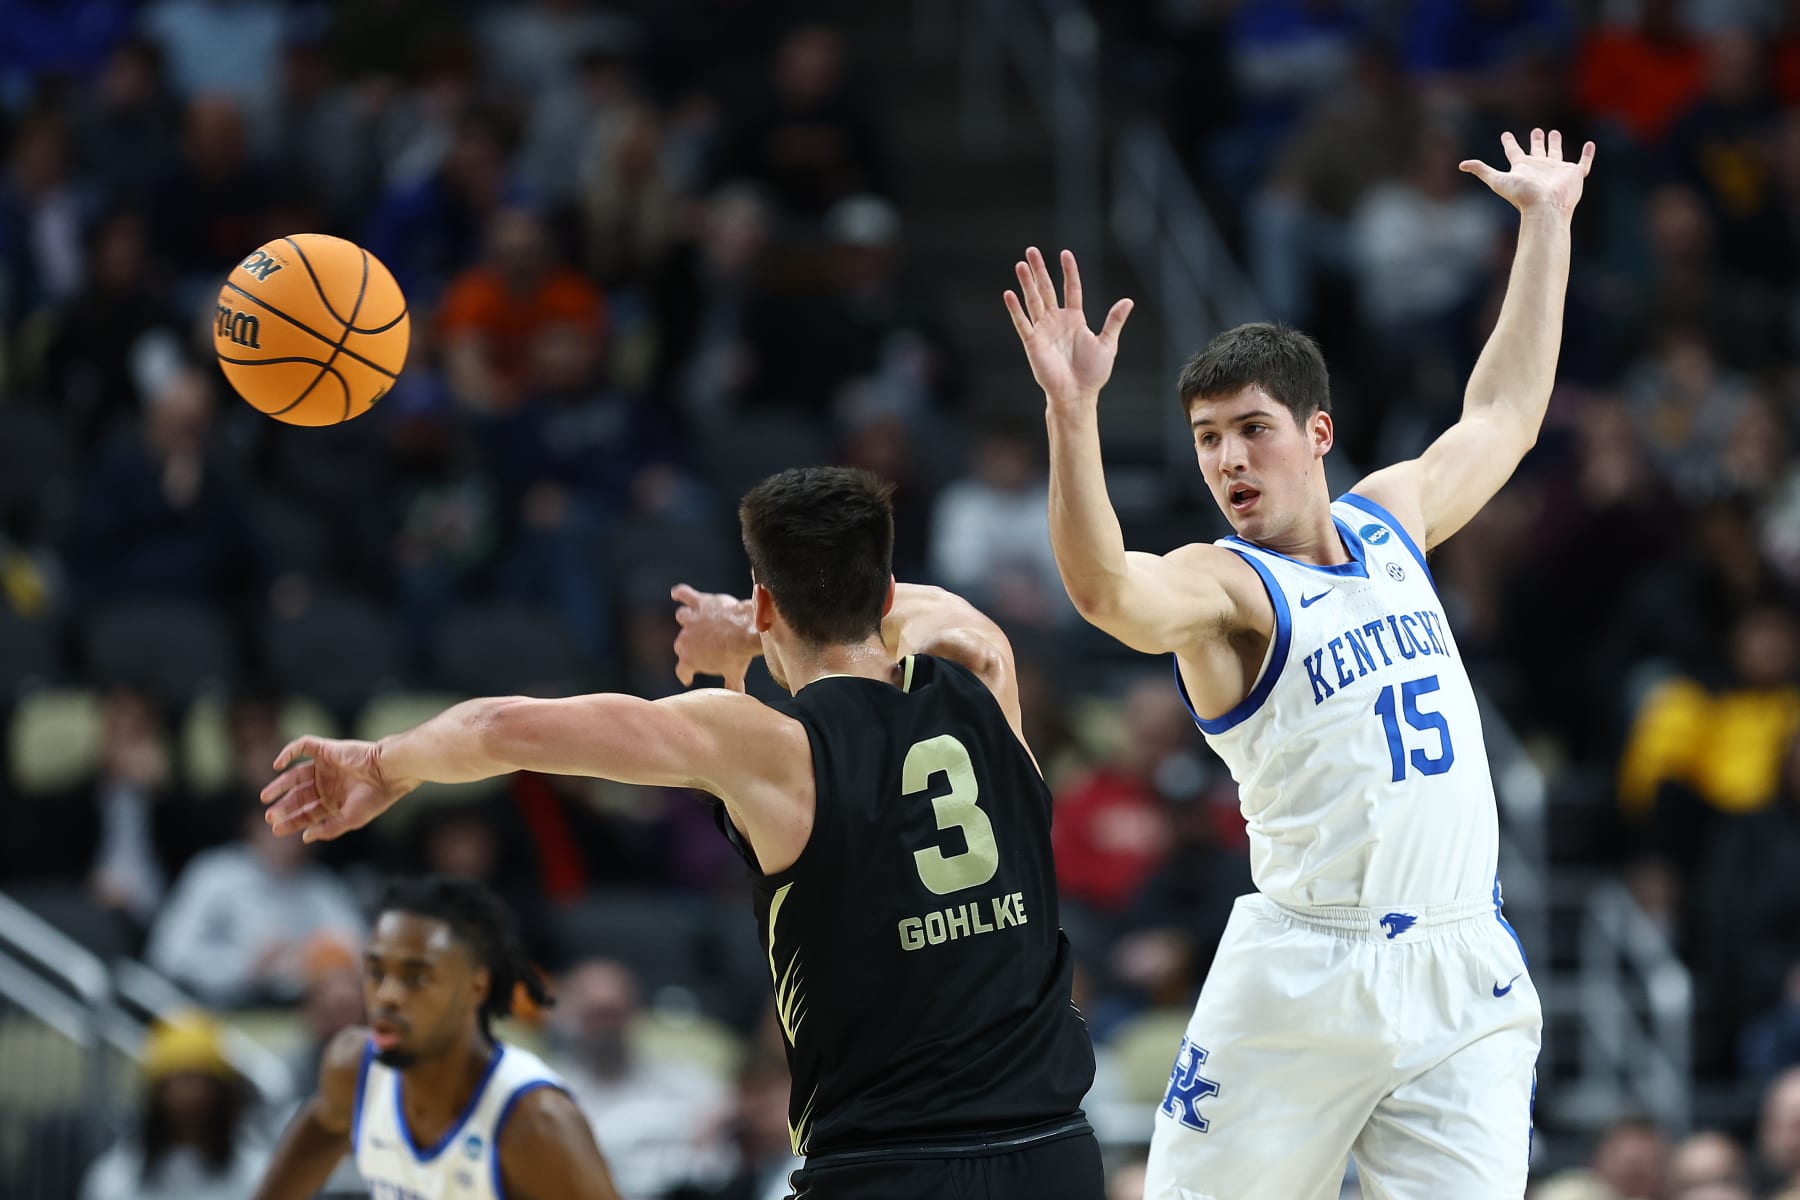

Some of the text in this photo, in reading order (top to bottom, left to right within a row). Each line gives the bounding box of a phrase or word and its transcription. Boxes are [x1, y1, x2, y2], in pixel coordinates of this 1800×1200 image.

[1374, 674, 1455, 783] 15
[902, 734, 999, 895] 3
[898, 892, 1028, 951] GOHLKE
